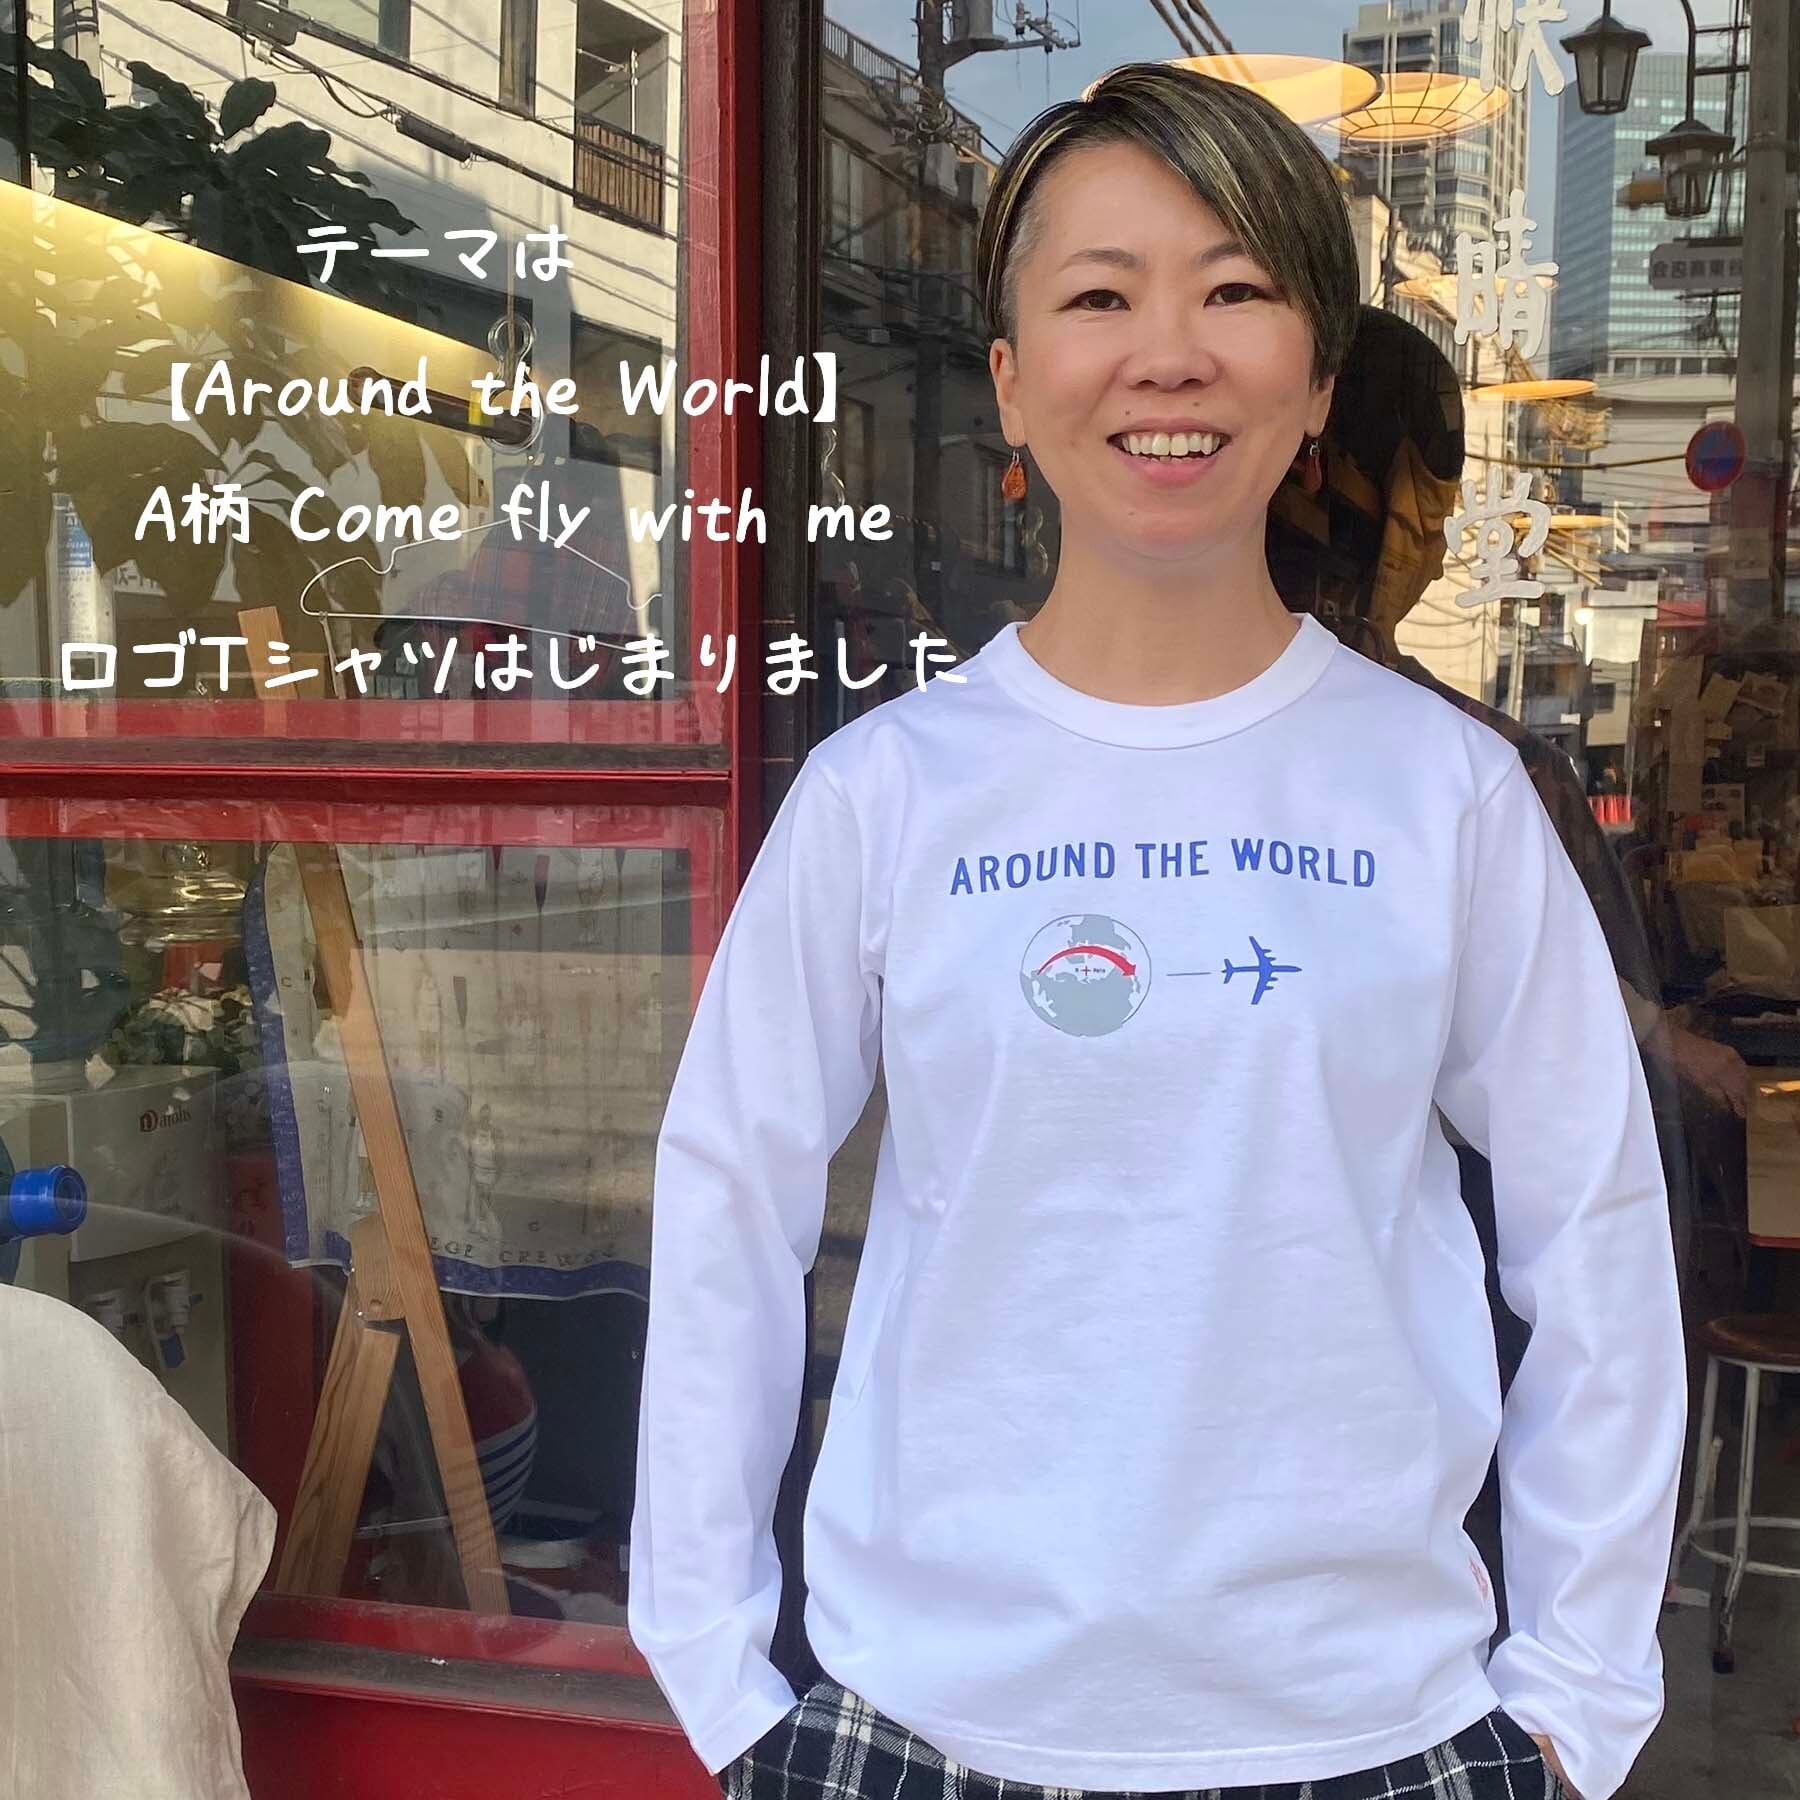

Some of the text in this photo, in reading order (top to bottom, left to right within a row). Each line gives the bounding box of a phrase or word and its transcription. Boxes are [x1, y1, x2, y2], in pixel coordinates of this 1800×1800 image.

[949, 837, 1377, 896] AROUND THE WORLD
